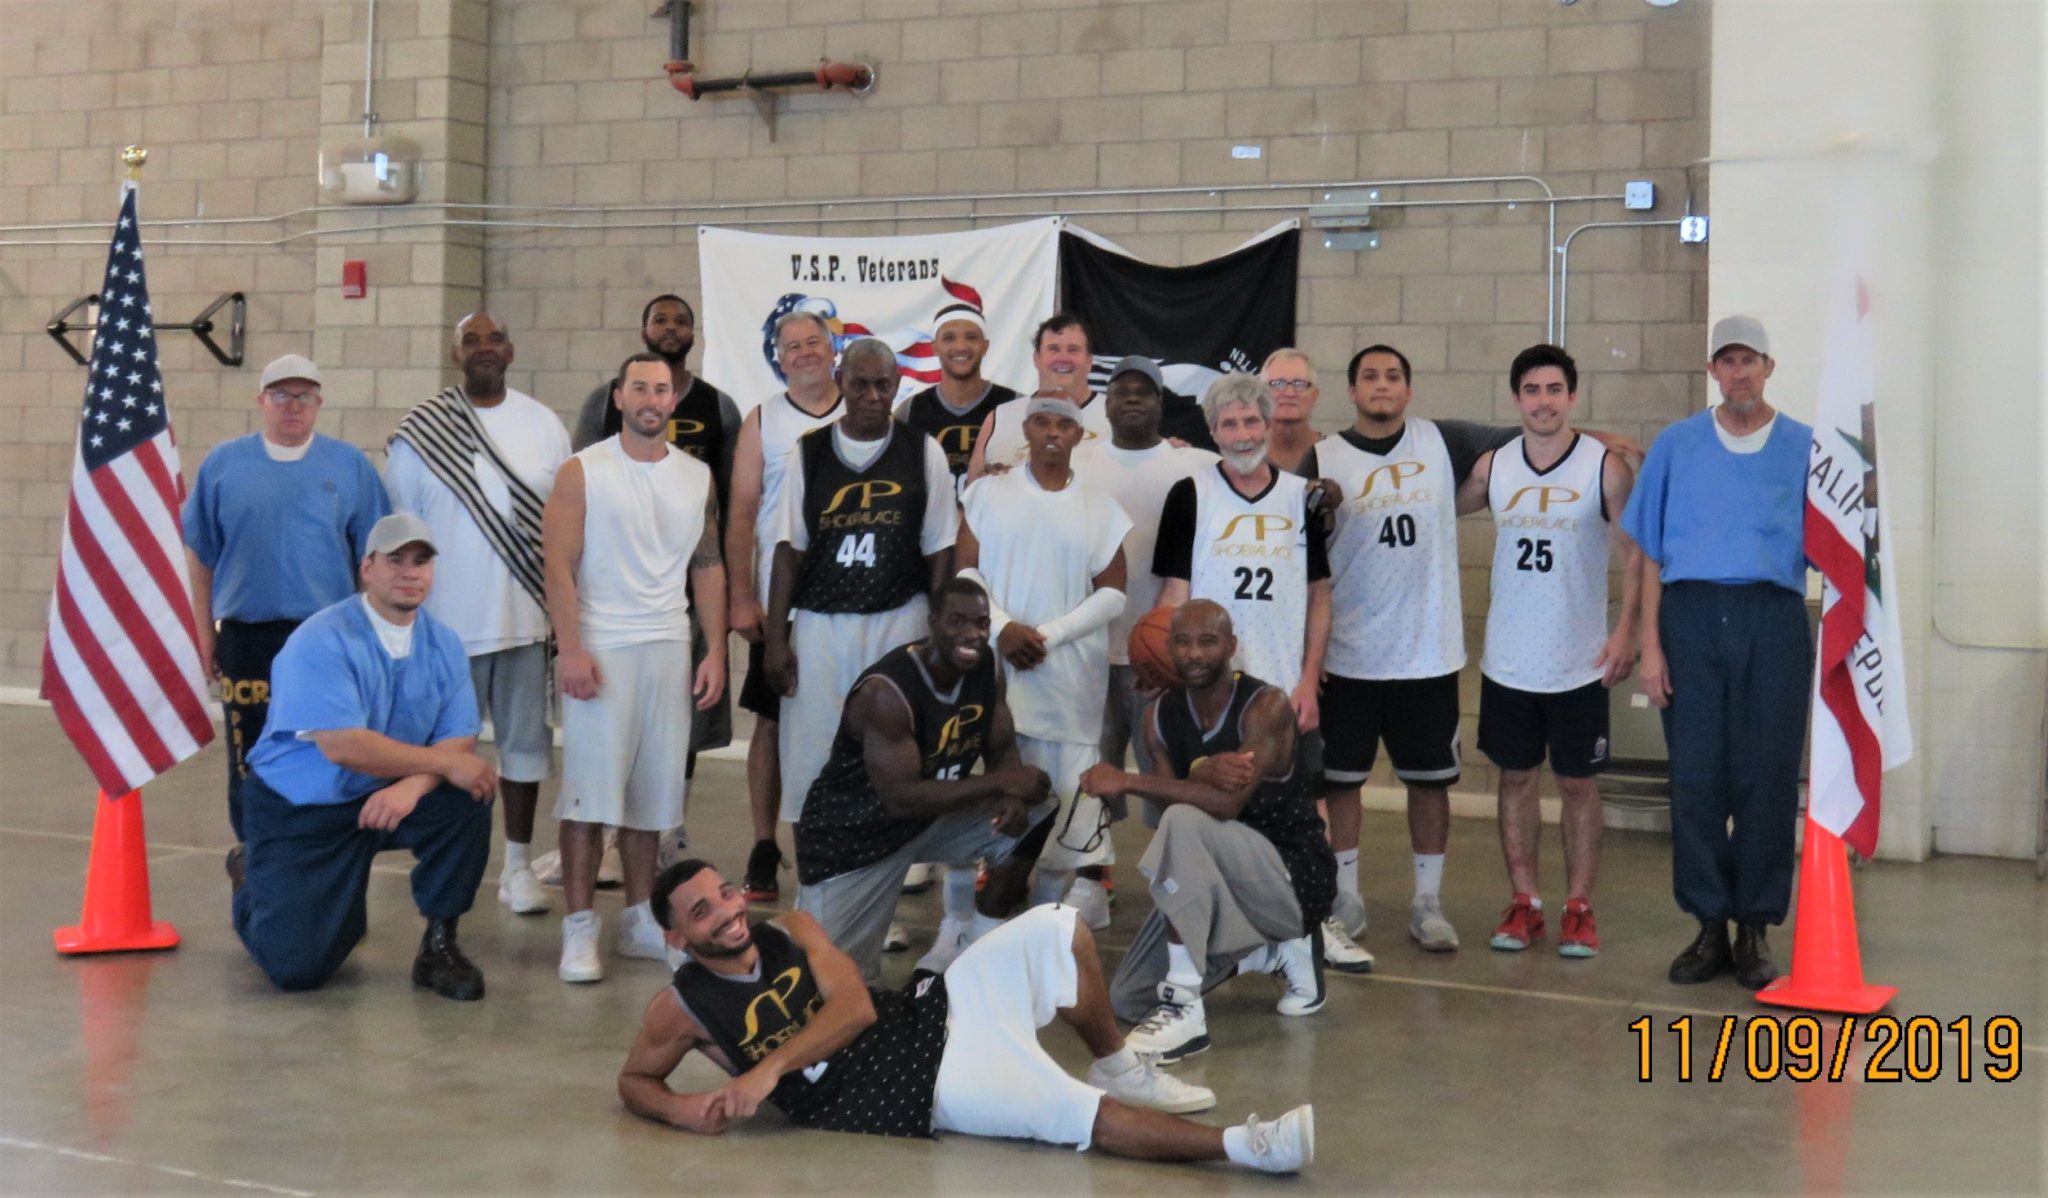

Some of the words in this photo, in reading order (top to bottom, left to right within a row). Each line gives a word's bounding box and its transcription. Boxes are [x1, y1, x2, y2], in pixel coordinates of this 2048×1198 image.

[791, 253, 846, 282] V.S.P.
[857, 255, 940, 283] Veterans
[1378, 513, 1416, 549] 40
[835, 532, 877, 568] 44
[1516, 537, 1554, 573] 25
[1234, 565, 1274, 601] 22
